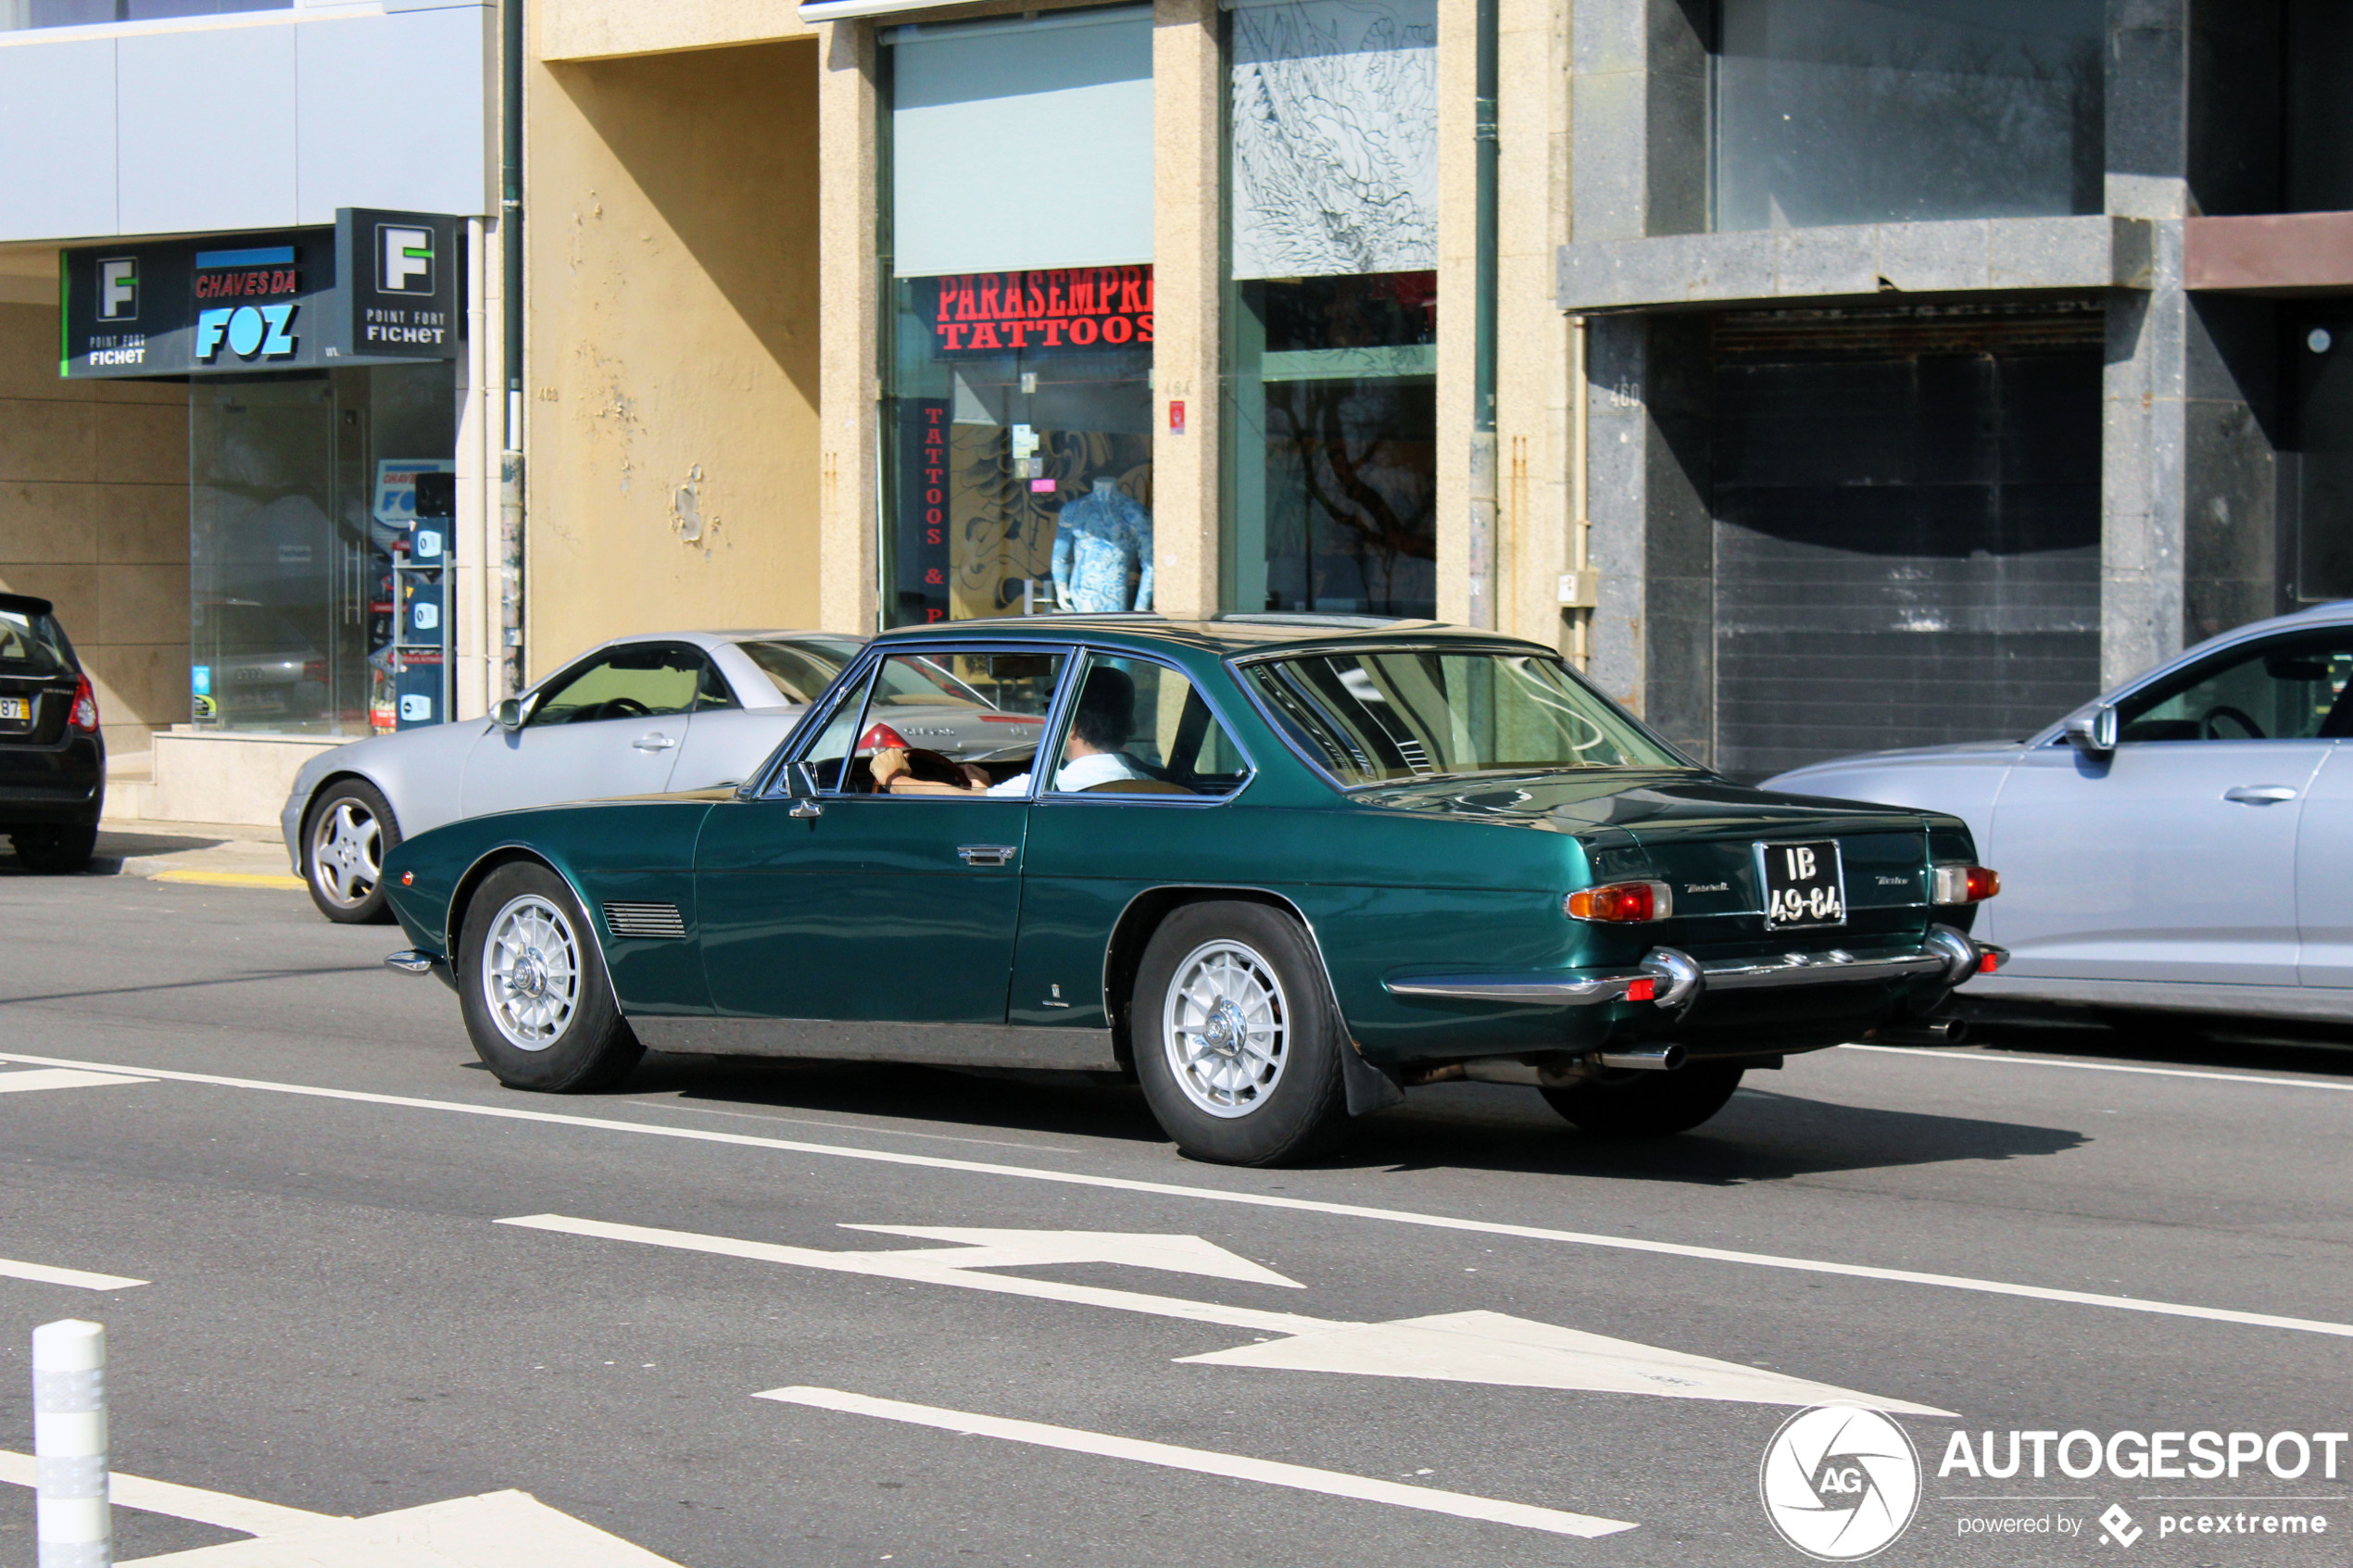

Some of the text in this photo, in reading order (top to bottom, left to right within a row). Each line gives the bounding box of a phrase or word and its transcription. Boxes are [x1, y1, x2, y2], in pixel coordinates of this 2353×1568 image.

[195, 270, 296, 298] CHAVES DA
[195, 304, 293, 358] FOZ
[366, 308, 445, 325] POINT FORT
[90, 335, 118, 348] POINT
[937, 315, 1154, 350] TATTOOS
[1610, 383, 1640, 408] 460
[925, 408, 943, 545] TATTOOS
[925, 568, 943, 584] &
[1786, 847, 1817, 881] IB
[1770, 886, 1841, 922] 49-84
